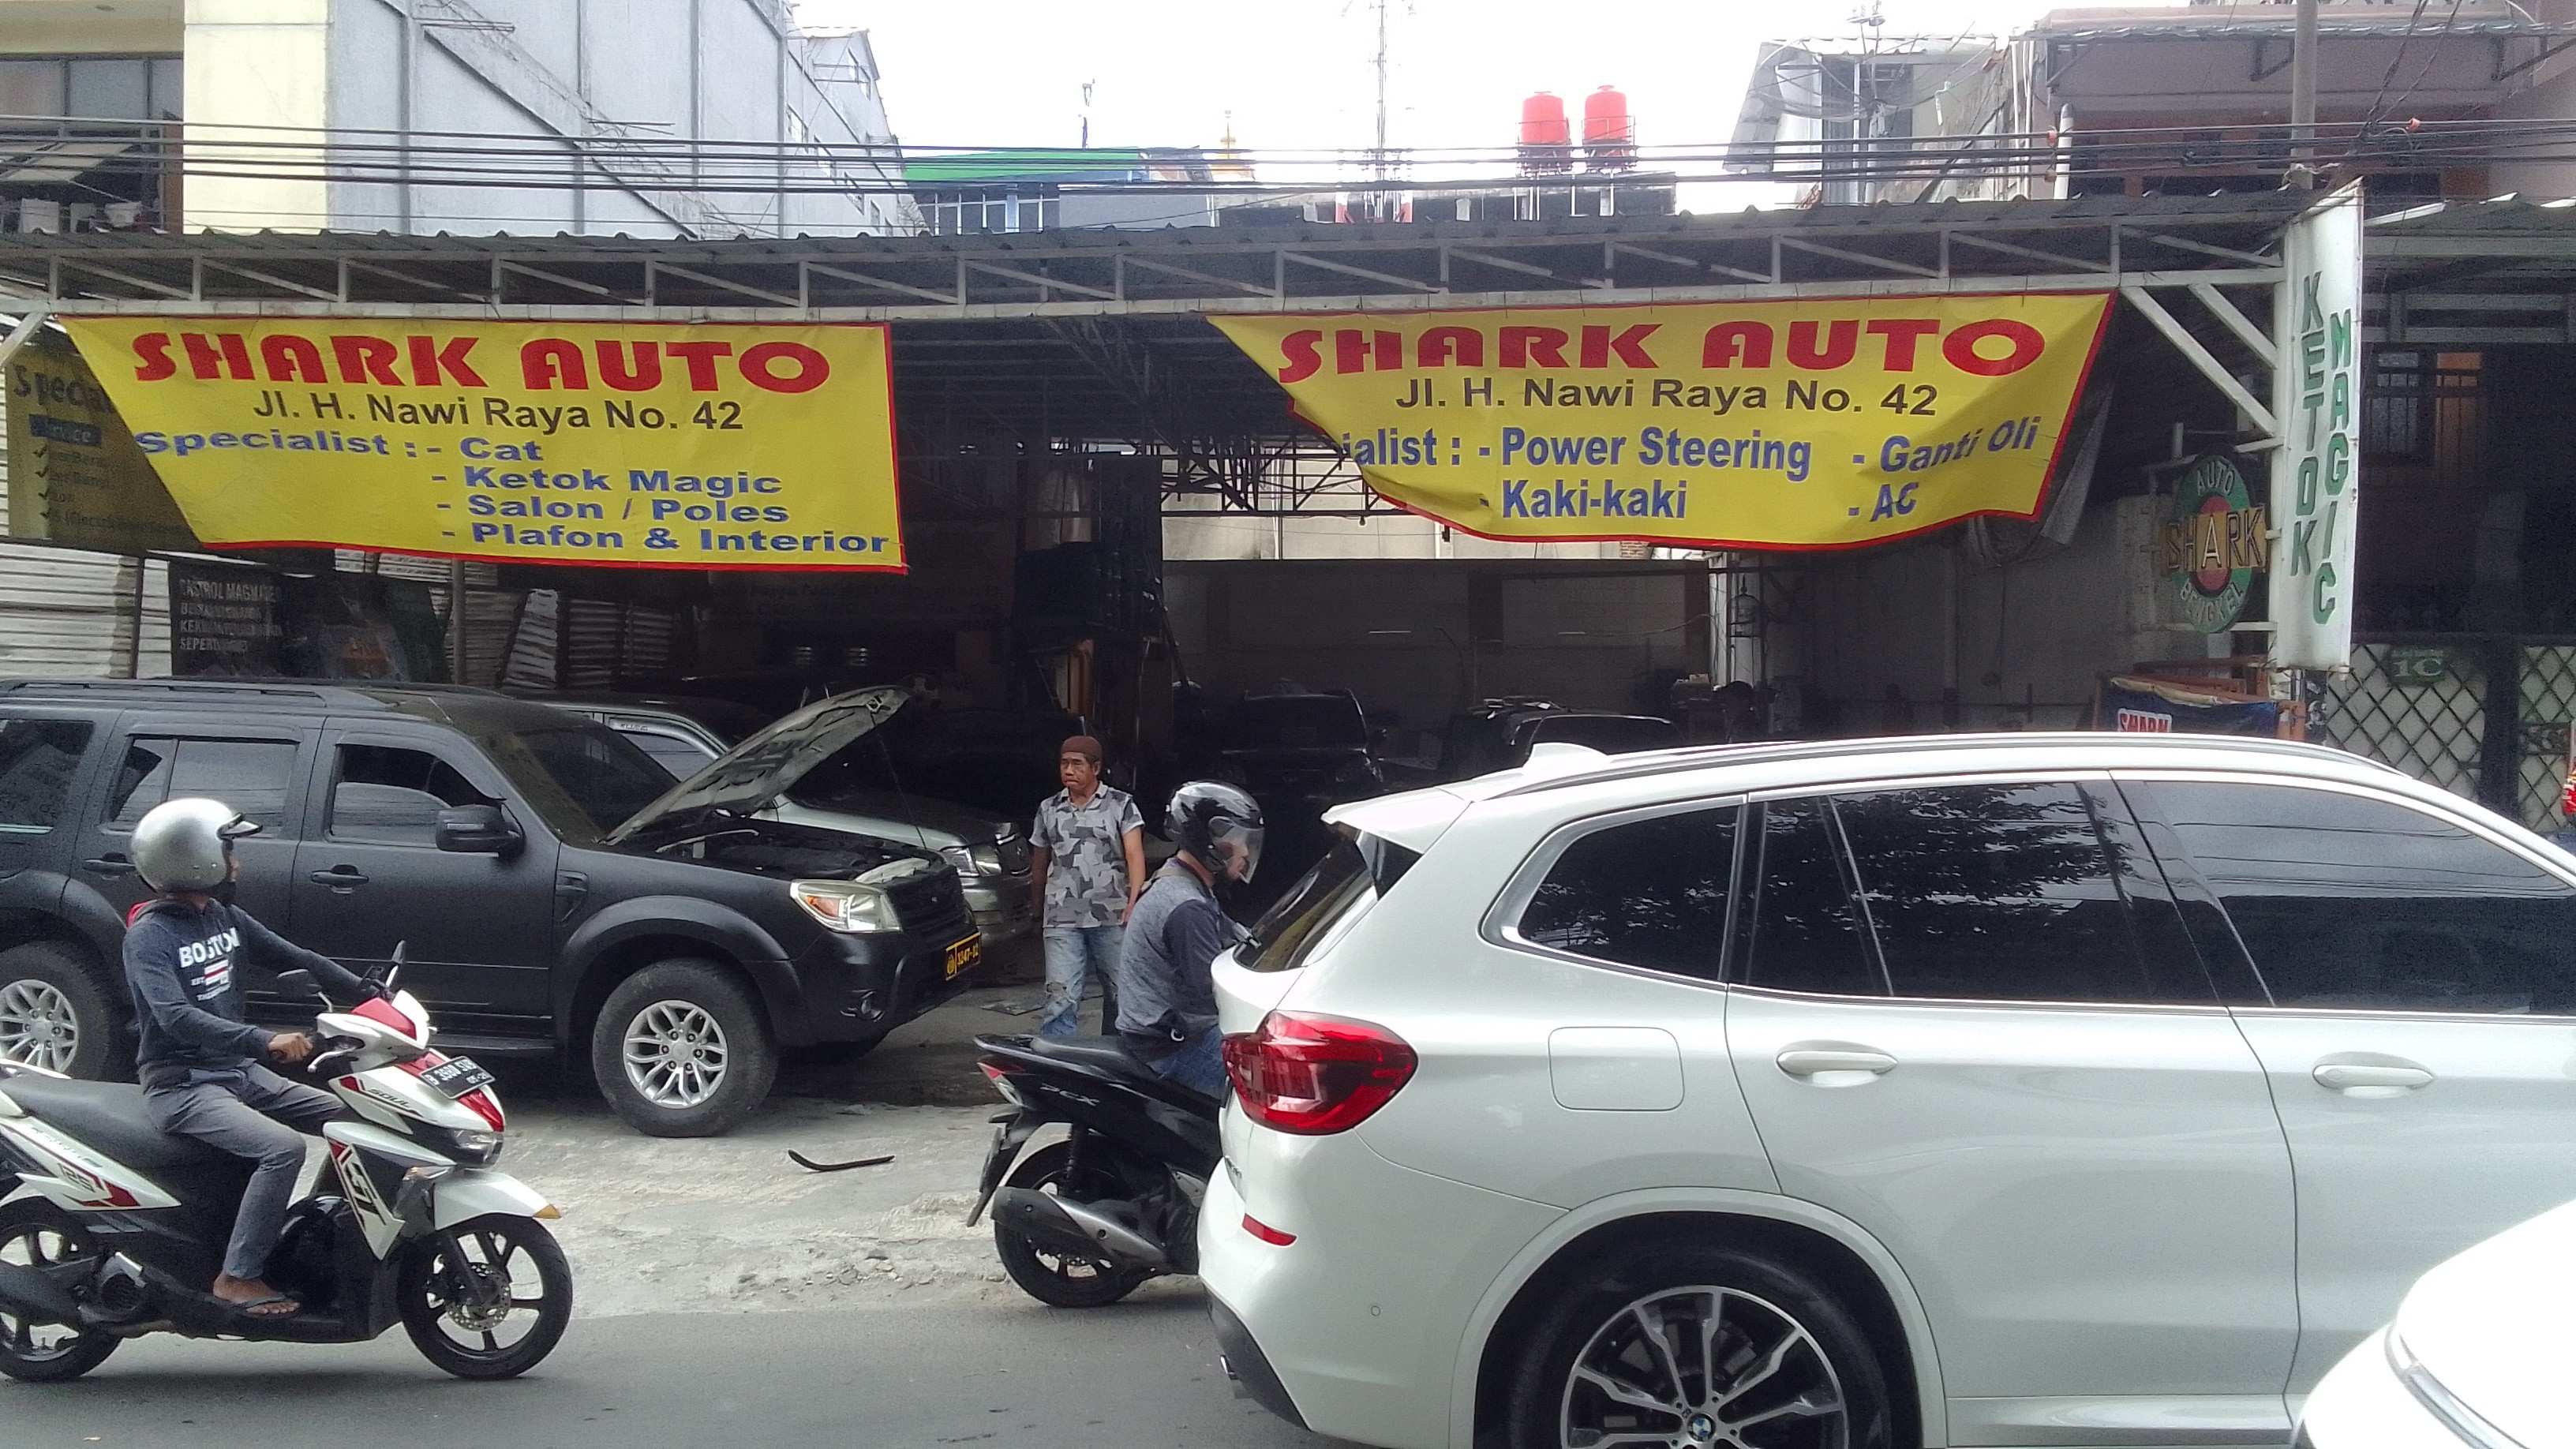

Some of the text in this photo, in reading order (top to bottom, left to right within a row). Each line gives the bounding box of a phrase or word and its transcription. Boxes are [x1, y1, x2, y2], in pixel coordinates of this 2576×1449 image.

[132, 332, 830, 394] SHARK AUTO
[1278, 318, 2046, 384] SHARK AUTO
[253, 390, 744, 435] Jl. H. Nawi Raya No. 42
[1395, 377, 1938, 417] Jl. H. Nawi Raya No. 42
[135, 428, 390, 457] Specialist
[460, 437, 544, 462] Cat
[1880, 427, 1982, 474] Ganti
[1986, 416, 2042, 453] Oli
[2290, 271, 2326, 577] KETOK
[1502, 427, 1626, 466] Power
[1638, 426, 1811, 481] Steering
[2312, 309, 2351, 626] MAGIC
[464, 465, 612, 492] Ketok
[628, 470, 783, 499] Magic
[2197, 458, 2235, 496] AUTO
[468, 494, 604, 521] Salon
[651, 498, 790, 523] Poles
[1502, 478, 1687, 520] Kaki-kaki
[1870, 481, 1919, 523] AC
[471, 522, 624, 549] Plafon
[643, 526, 680, 550] &
[700, 528, 889, 554] Interior
[2168, 508, 2264, 570] SHARK
[178, 927, 241, 968] BOSTON
